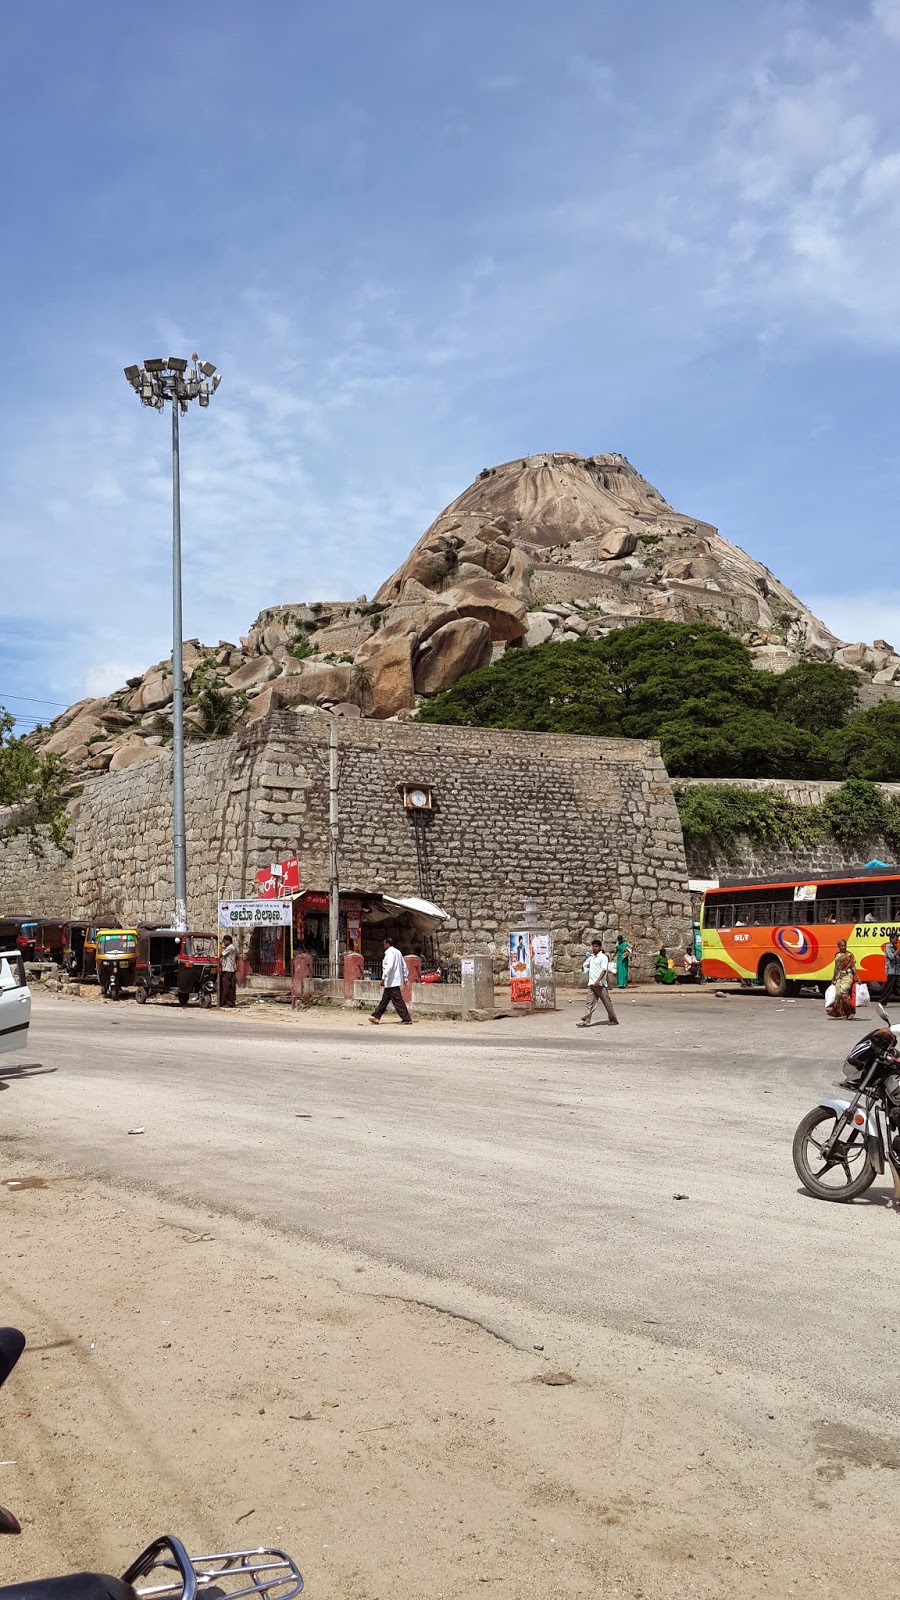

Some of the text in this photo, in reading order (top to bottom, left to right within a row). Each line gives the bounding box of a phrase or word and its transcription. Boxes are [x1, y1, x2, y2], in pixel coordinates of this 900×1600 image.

[312, 896, 327, 904] airtel
[855, 927, 870, 938] R.K
[872, 926, 878, 937] &
